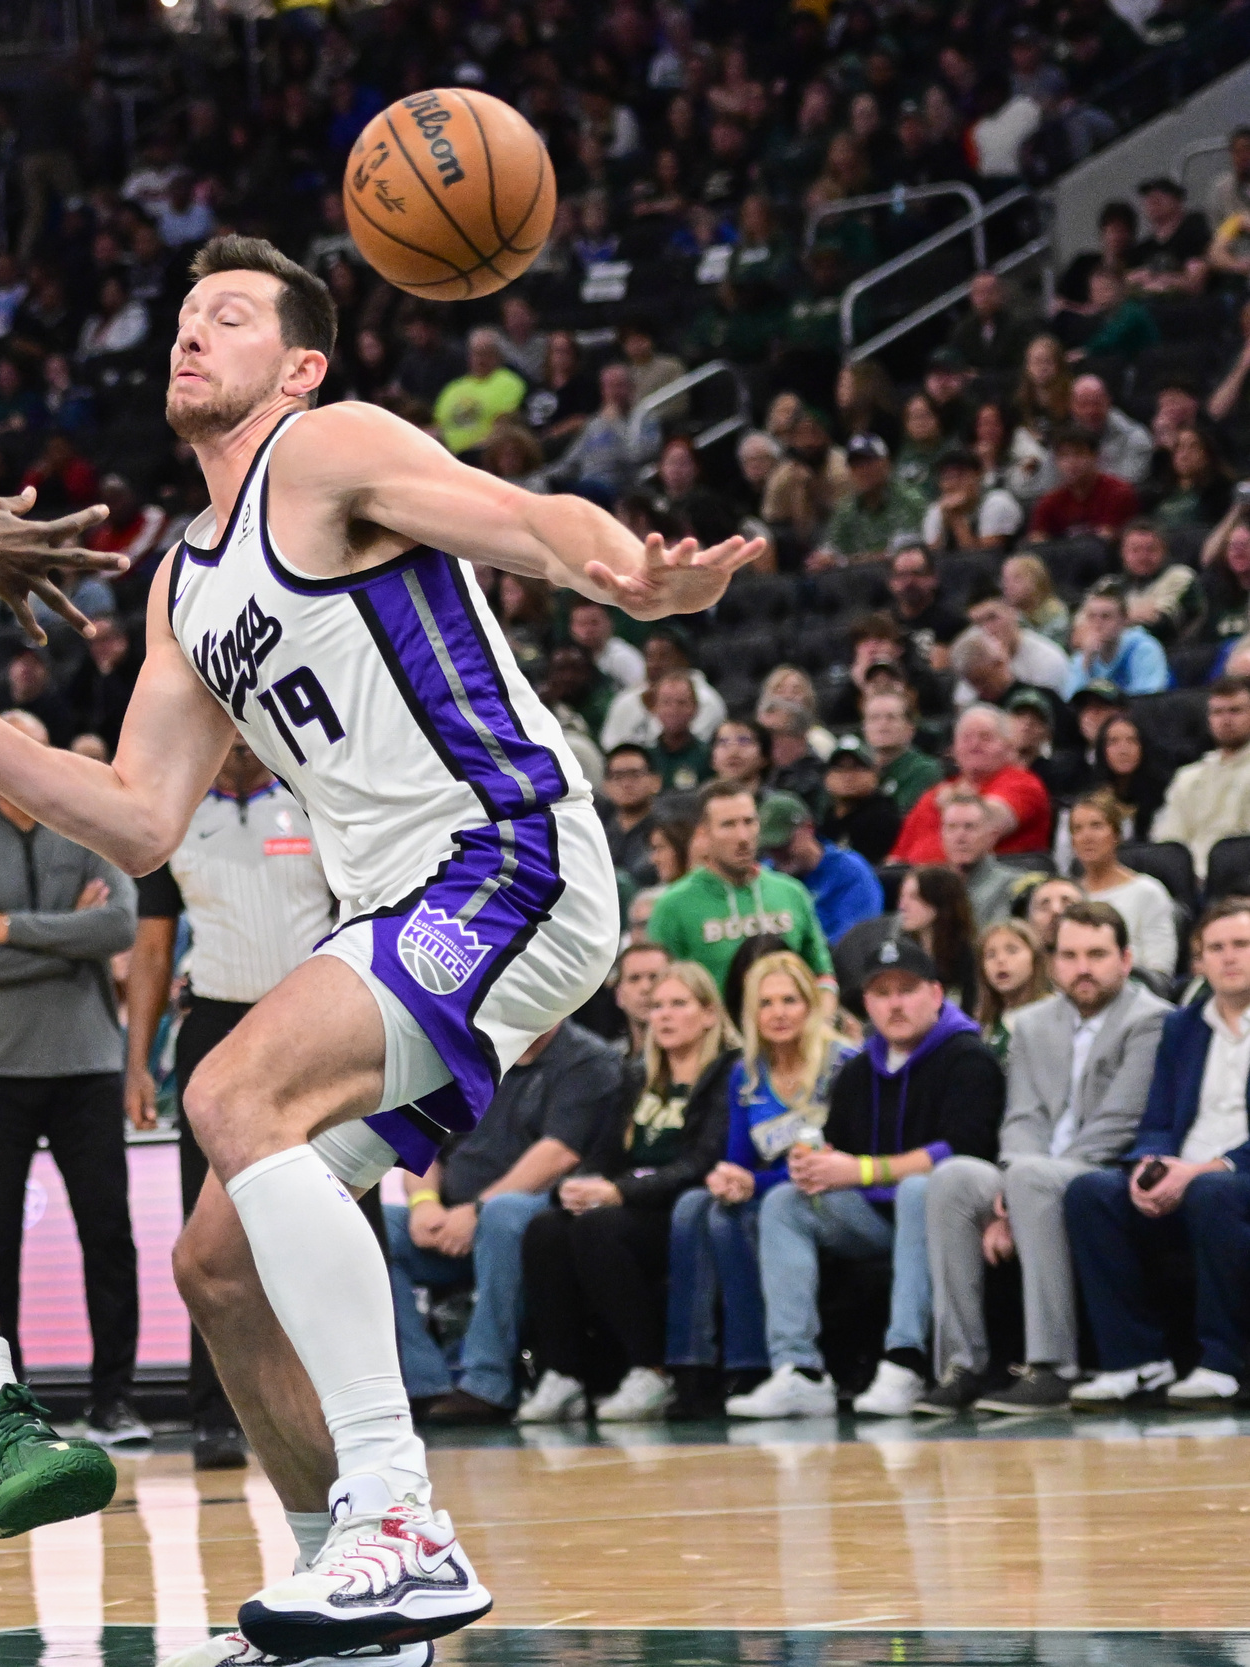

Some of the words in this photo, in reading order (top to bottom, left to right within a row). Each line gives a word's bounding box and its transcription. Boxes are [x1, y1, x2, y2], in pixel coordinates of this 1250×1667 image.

[192, 593, 283, 725] Kings
[257, 666, 346, 767] 19
[404, 925, 469, 984] KINGS
[414, 918, 474, 967] SACRAMENTO
[703, 911, 794, 944] BUCKS
